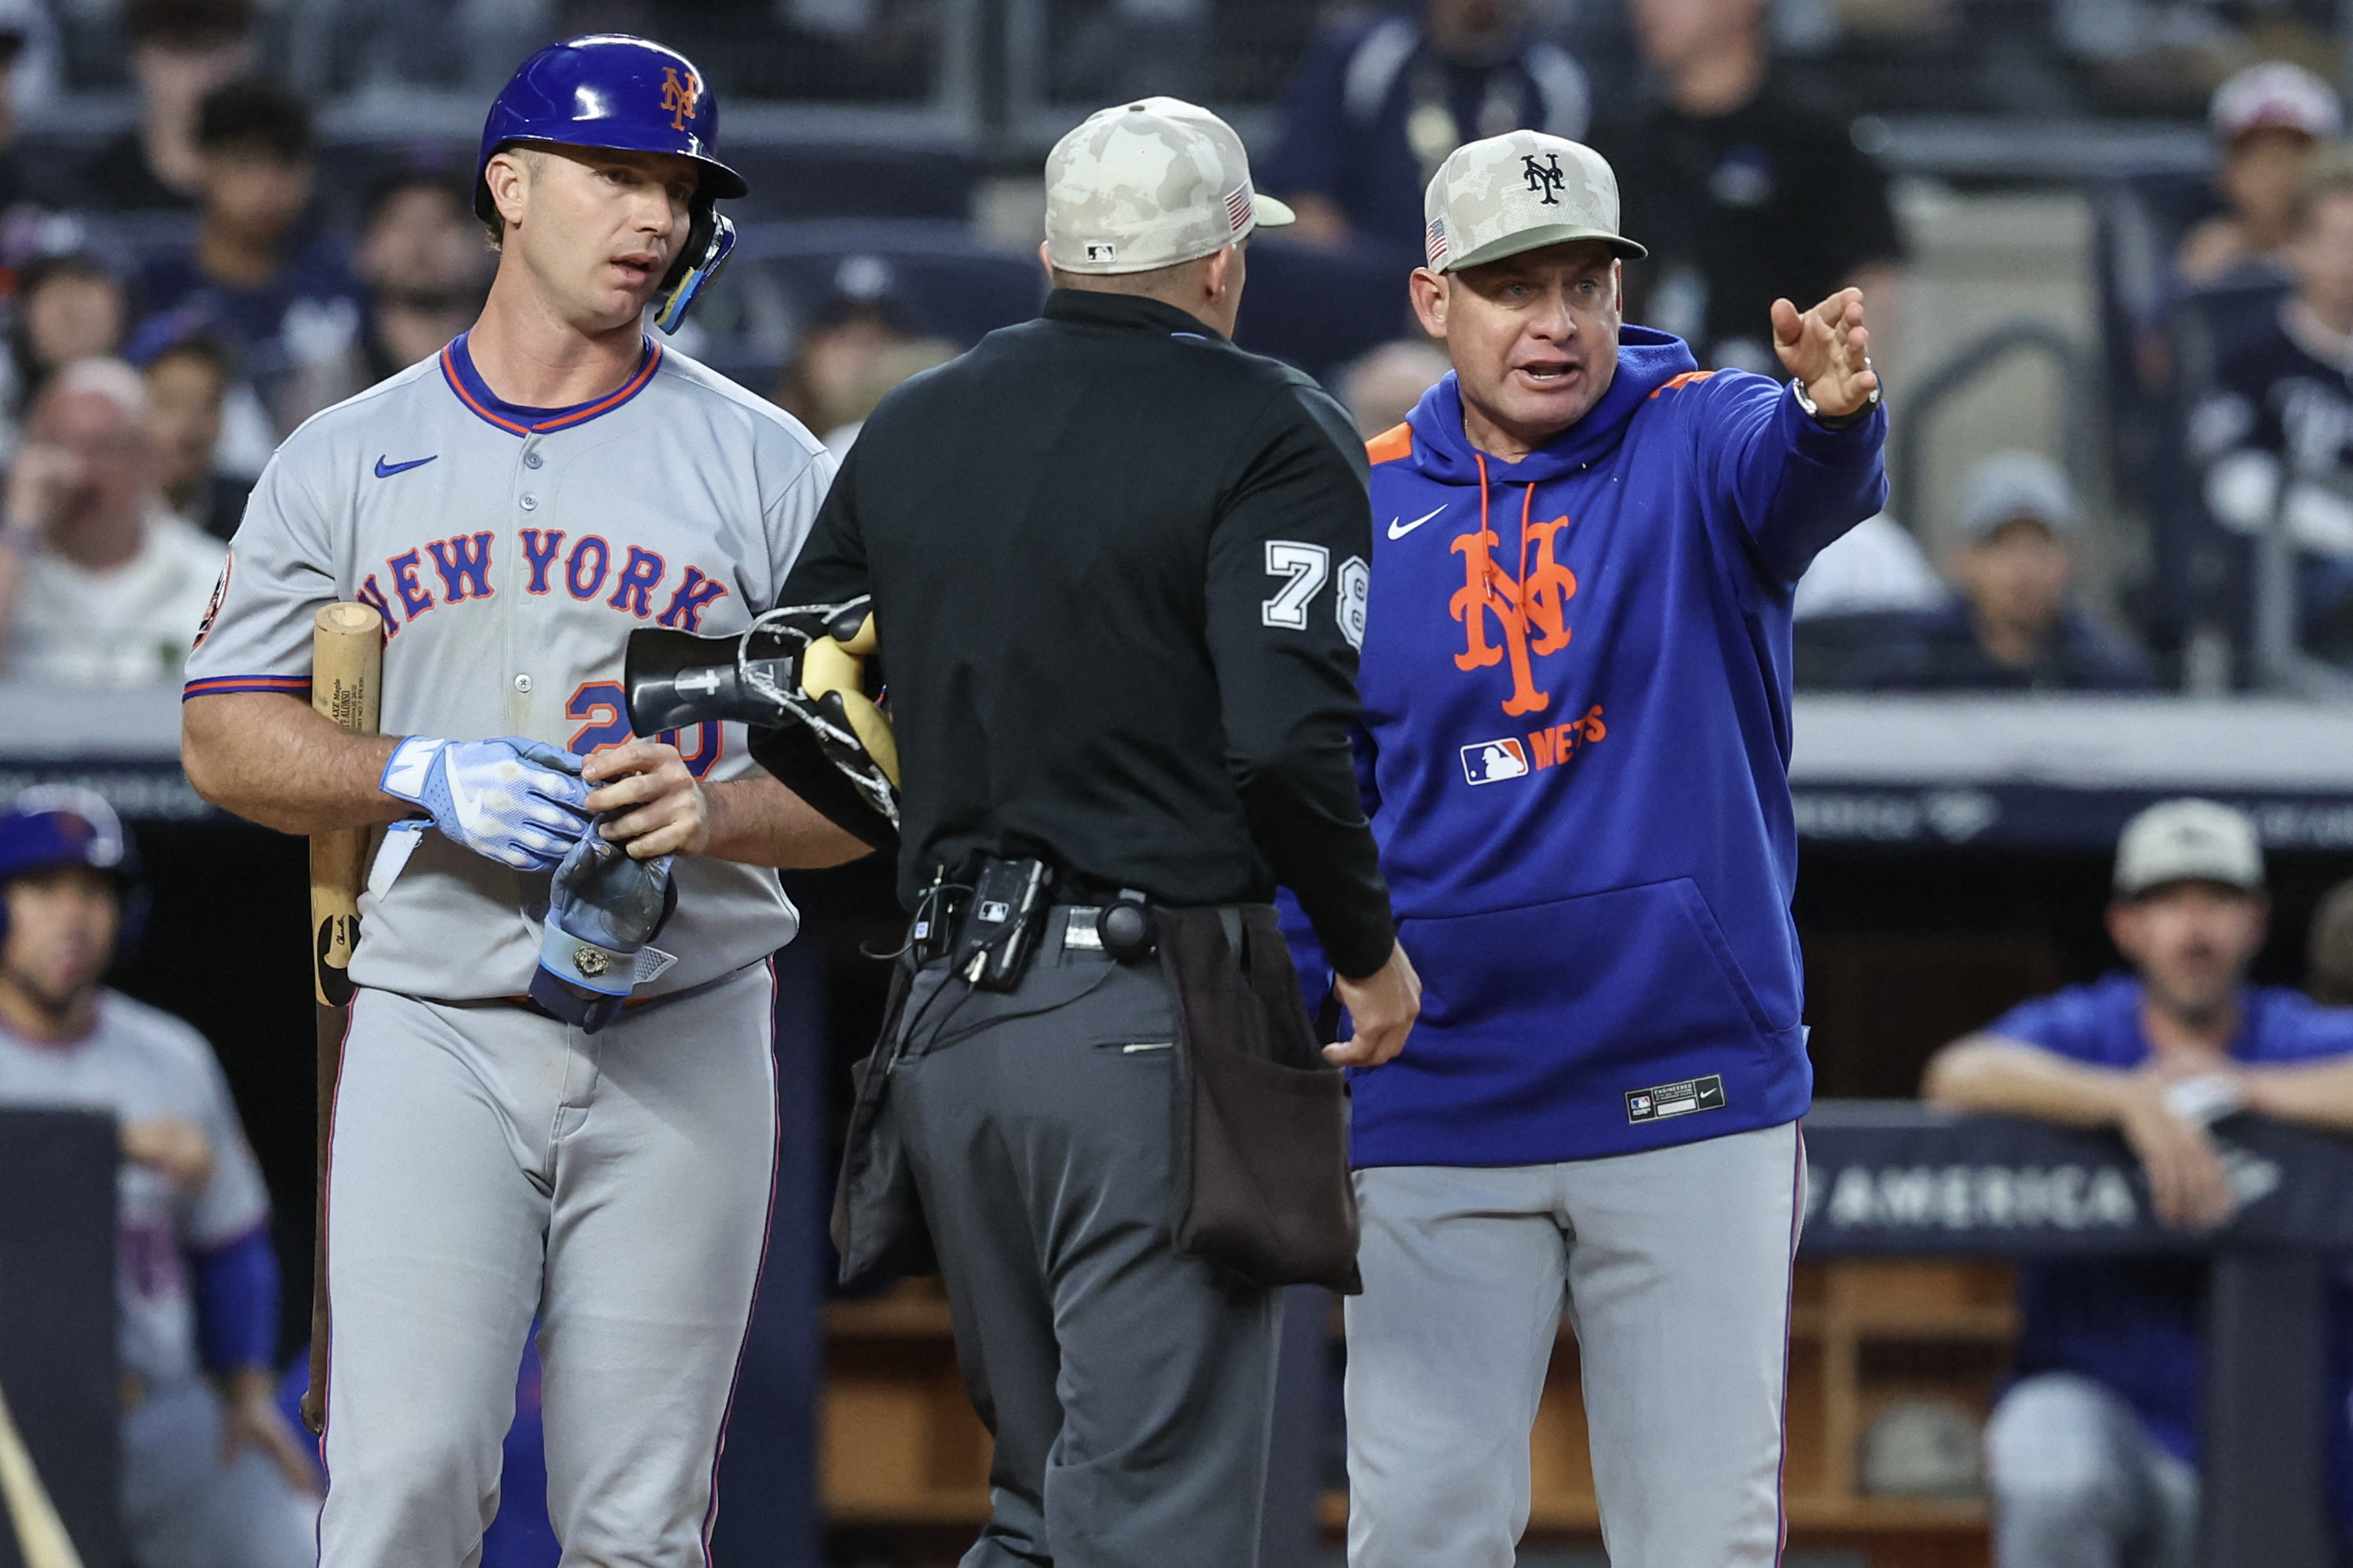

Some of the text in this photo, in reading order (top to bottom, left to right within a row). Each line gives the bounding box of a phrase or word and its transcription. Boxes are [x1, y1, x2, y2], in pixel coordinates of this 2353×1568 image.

[1520, 153, 1565, 204] NY
[356, 528, 729, 650] NEW YORK
[1262, 540, 1371, 654] 78
[332, 700, 340, 721] AXE
[340, 690, 350, 718] ALONSO
[1527, 704, 1607, 771] METS
